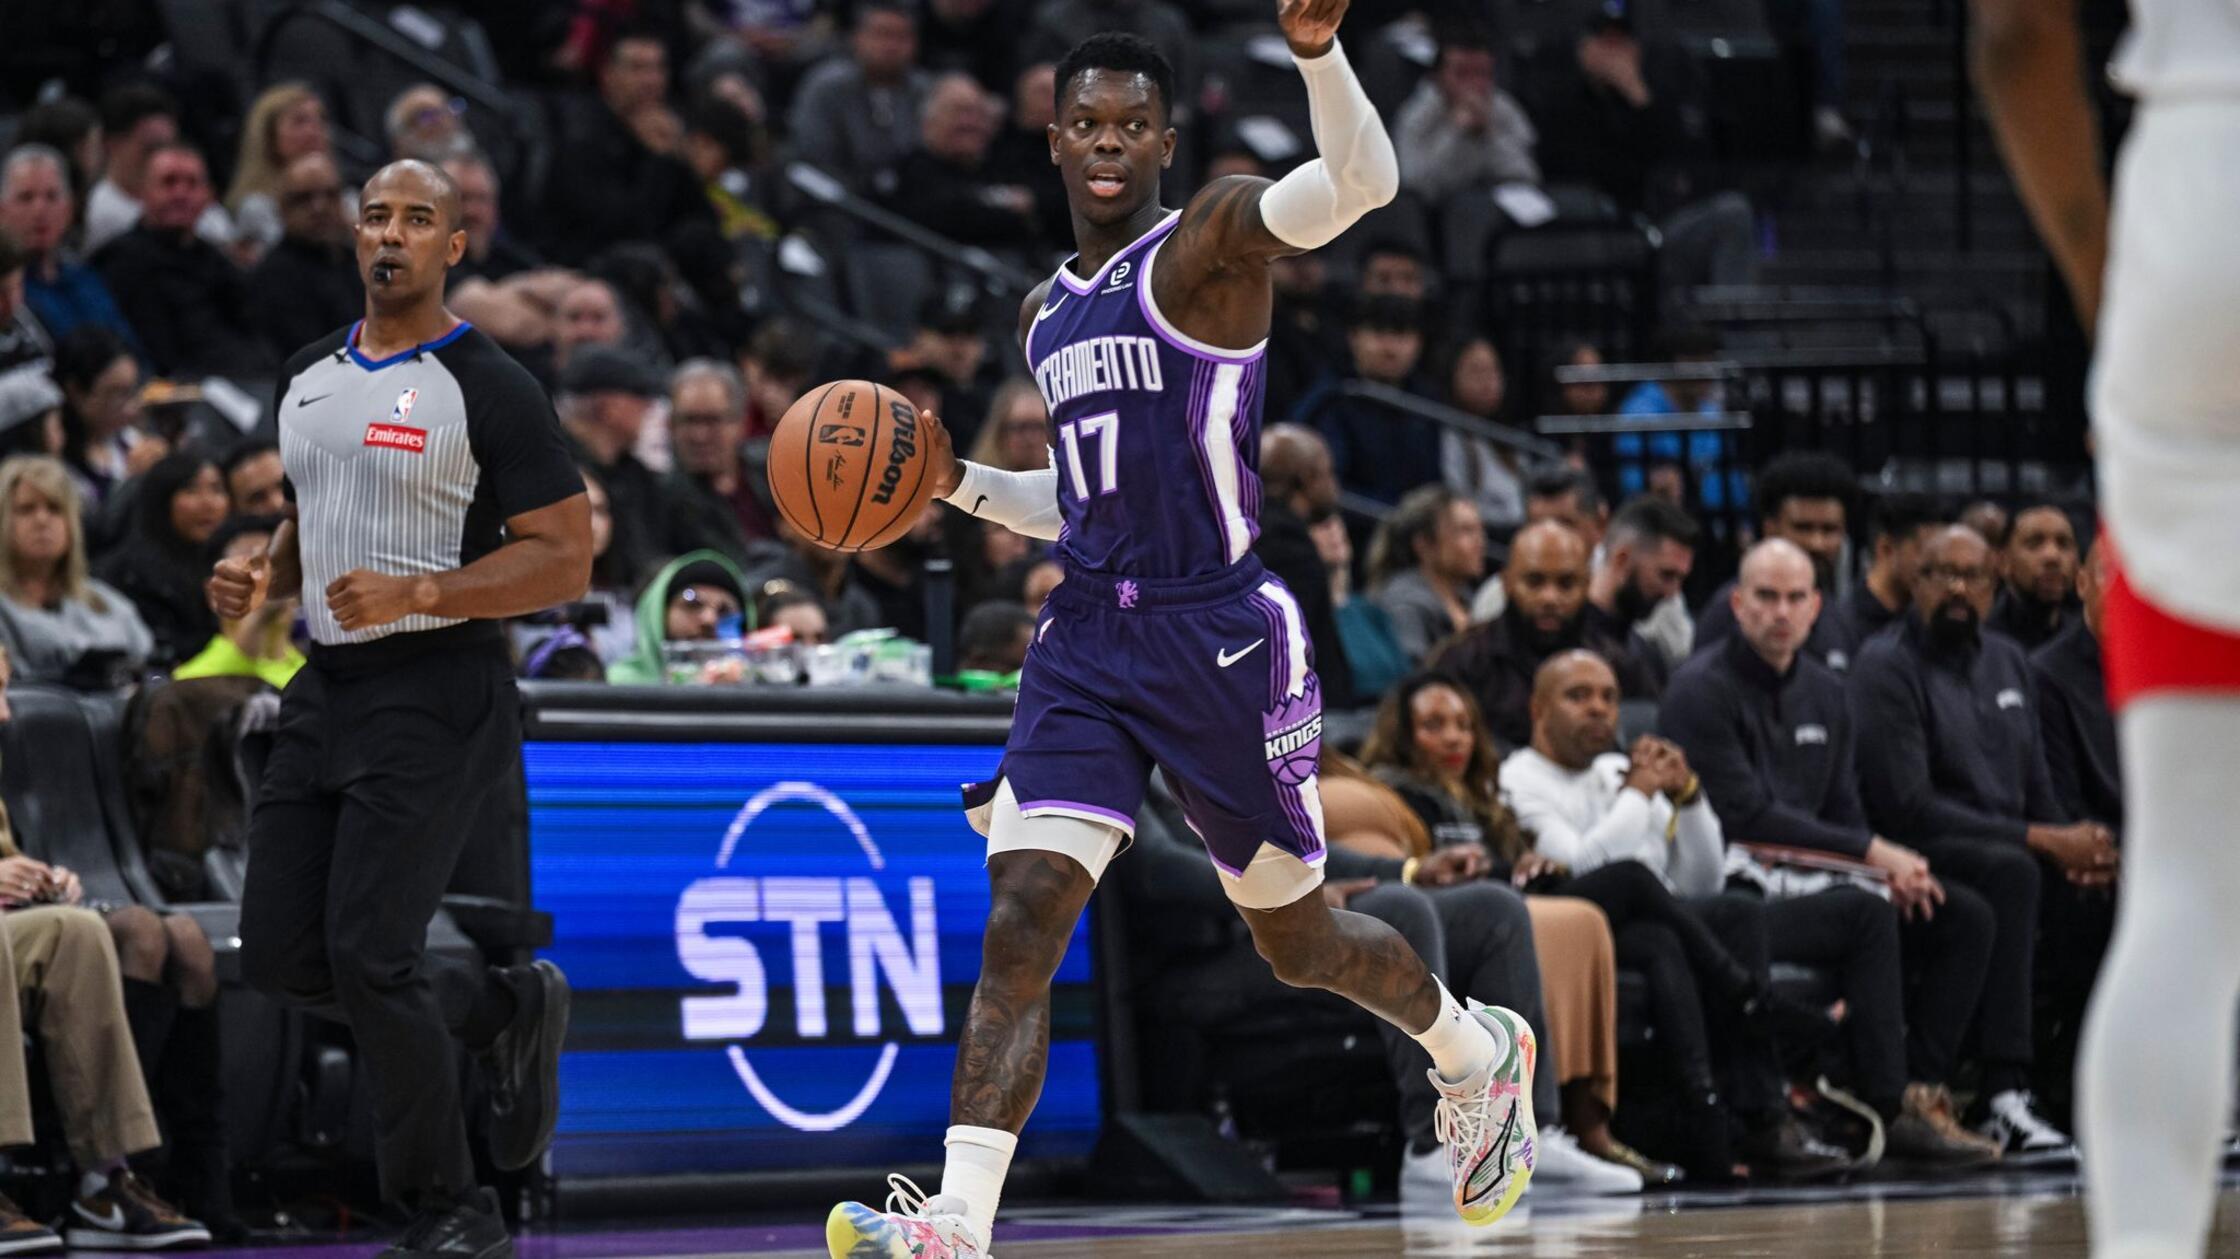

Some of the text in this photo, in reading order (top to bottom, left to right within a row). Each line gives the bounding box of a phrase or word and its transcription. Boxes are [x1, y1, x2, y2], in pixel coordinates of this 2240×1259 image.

[1035, 335, 1163, 416] CRAMENTO
[366, 426, 424, 448] Emirates
[871, 400, 917, 506] Wilson
[1060, 409, 1119, 502] 17
[1264, 715, 1322, 761] KINGS
[675, 876, 945, 1041] STN
